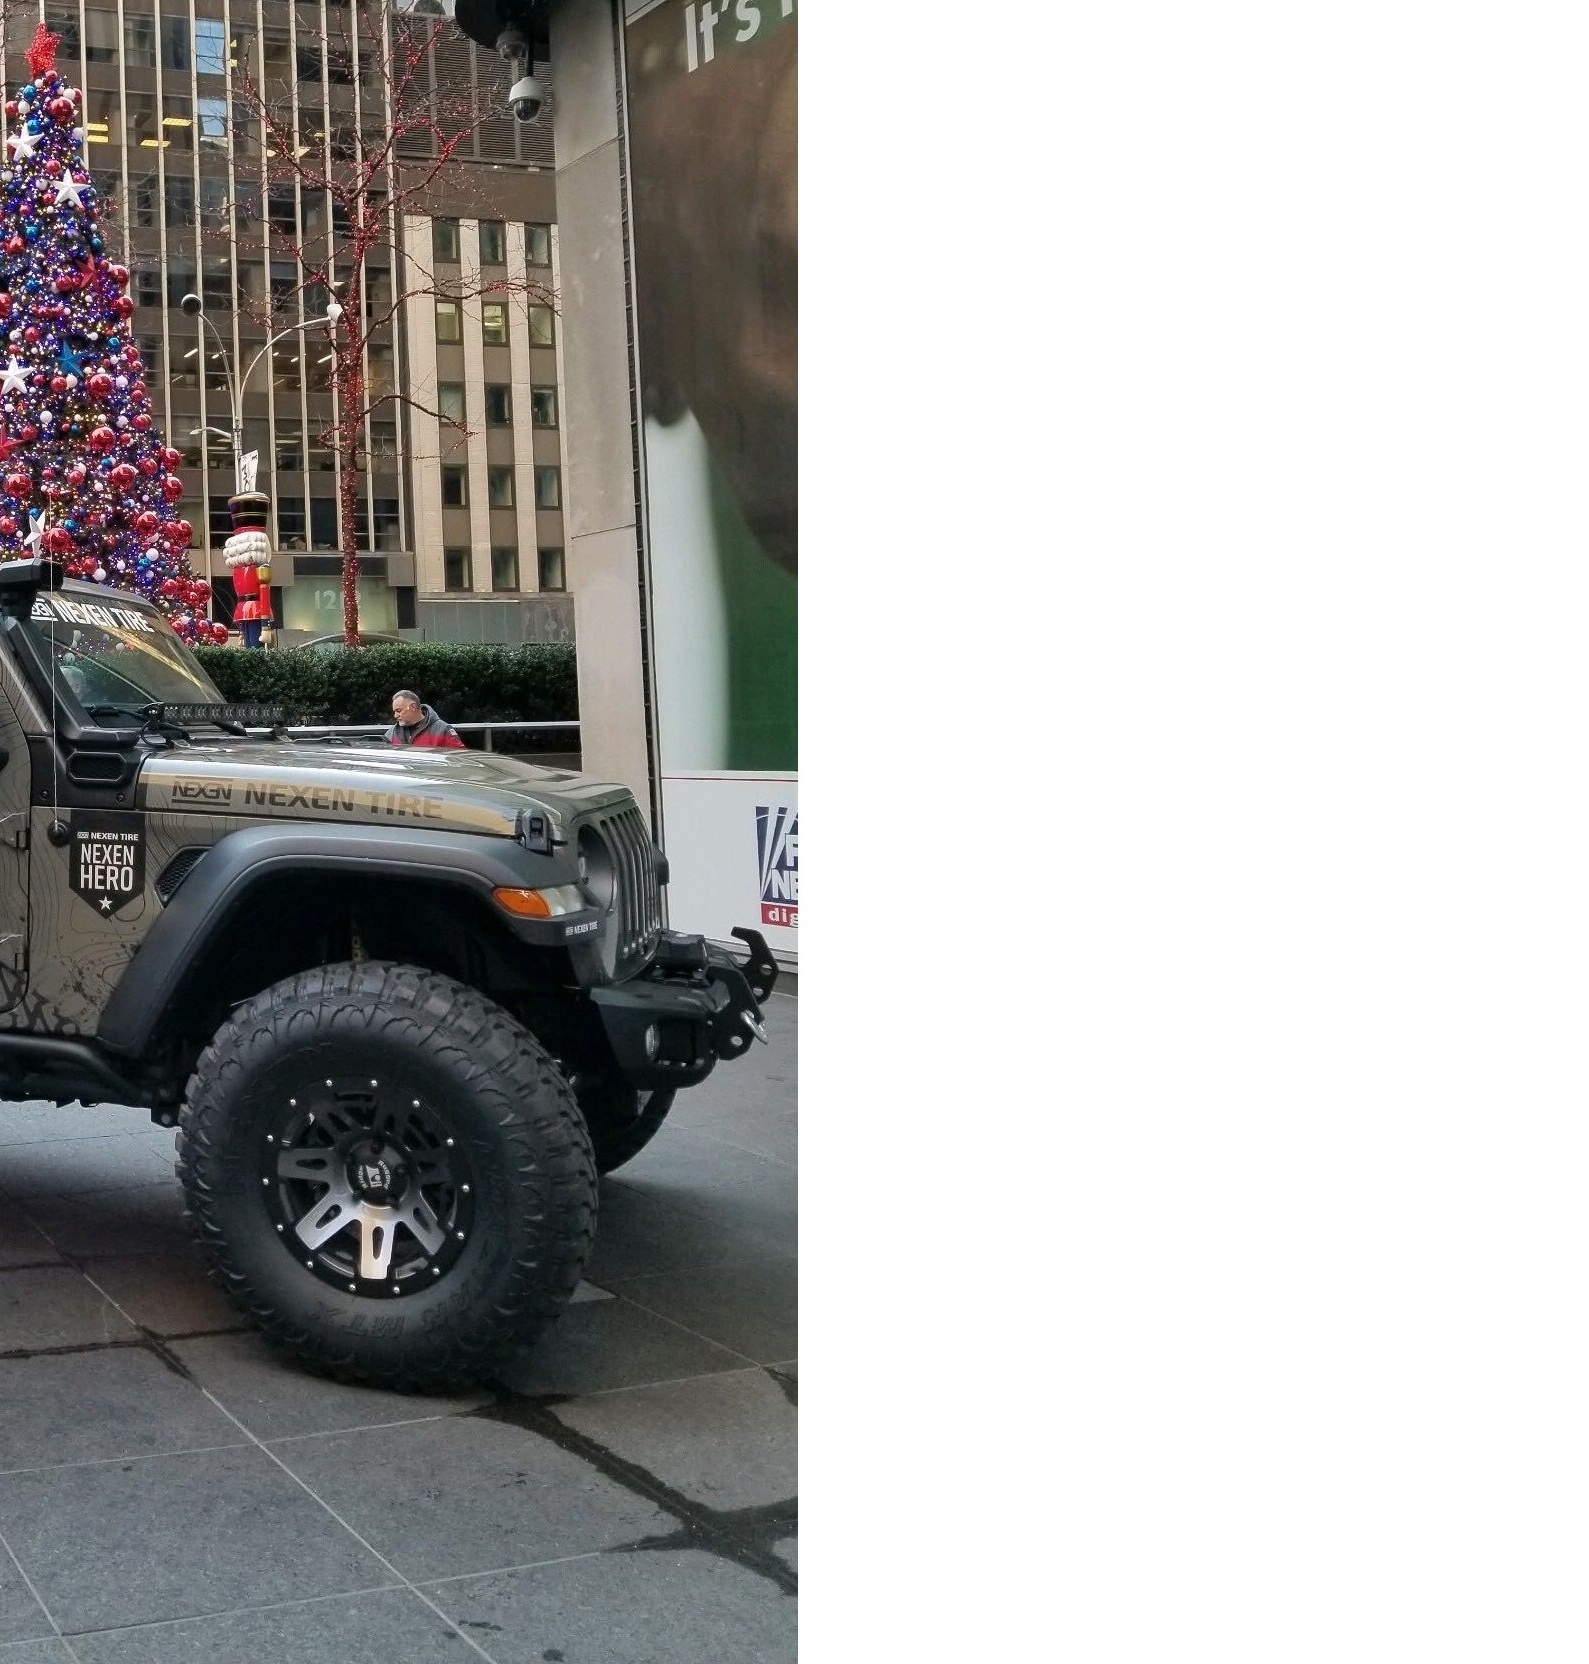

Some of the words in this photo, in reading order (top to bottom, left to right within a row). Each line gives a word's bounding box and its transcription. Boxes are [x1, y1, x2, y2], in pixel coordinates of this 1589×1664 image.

[51, 600, 119, 628] NEXEN
[111, 608, 155, 632] TIRE
[245, 782, 354, 811] NEXEN
[366, 790, 443, 819] TIRE
[91, 832, 118, 840] NEXEN
[120, 833, 139, 841] TIRE
[80, 843, 134, 865] NEXEN
[80, 864, 133, 891] HERO
